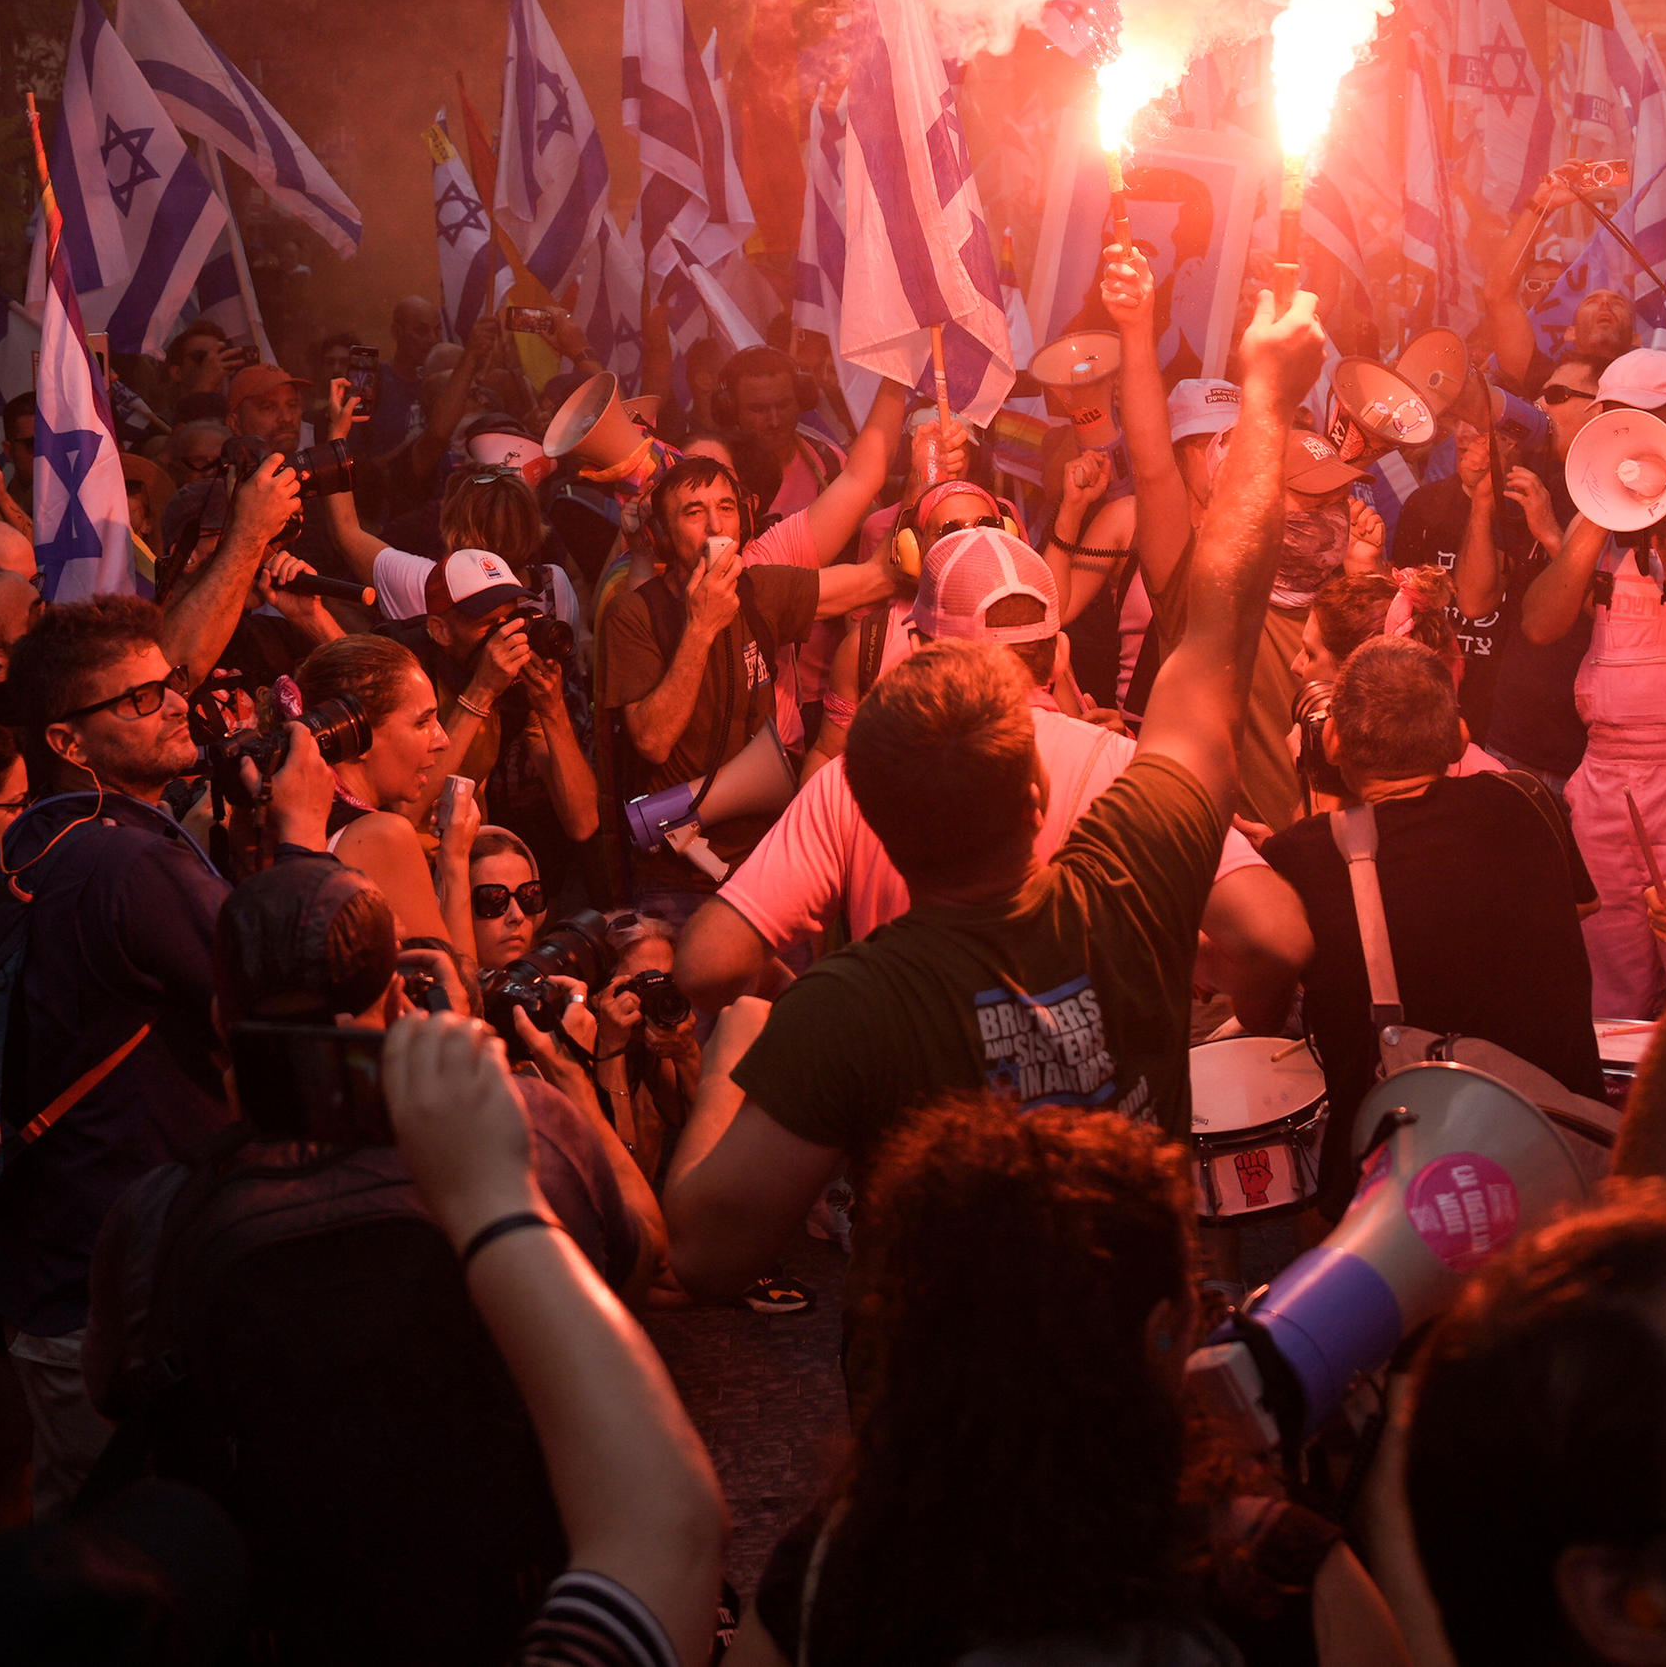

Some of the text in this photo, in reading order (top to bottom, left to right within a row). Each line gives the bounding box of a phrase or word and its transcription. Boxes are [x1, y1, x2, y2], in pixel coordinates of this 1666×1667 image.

[976, 988, 1102, 1042] BROHERS
[984, 1019, 1106, 1069] AND SISTERS
[1019, 1061, 1043, 1102] IN
